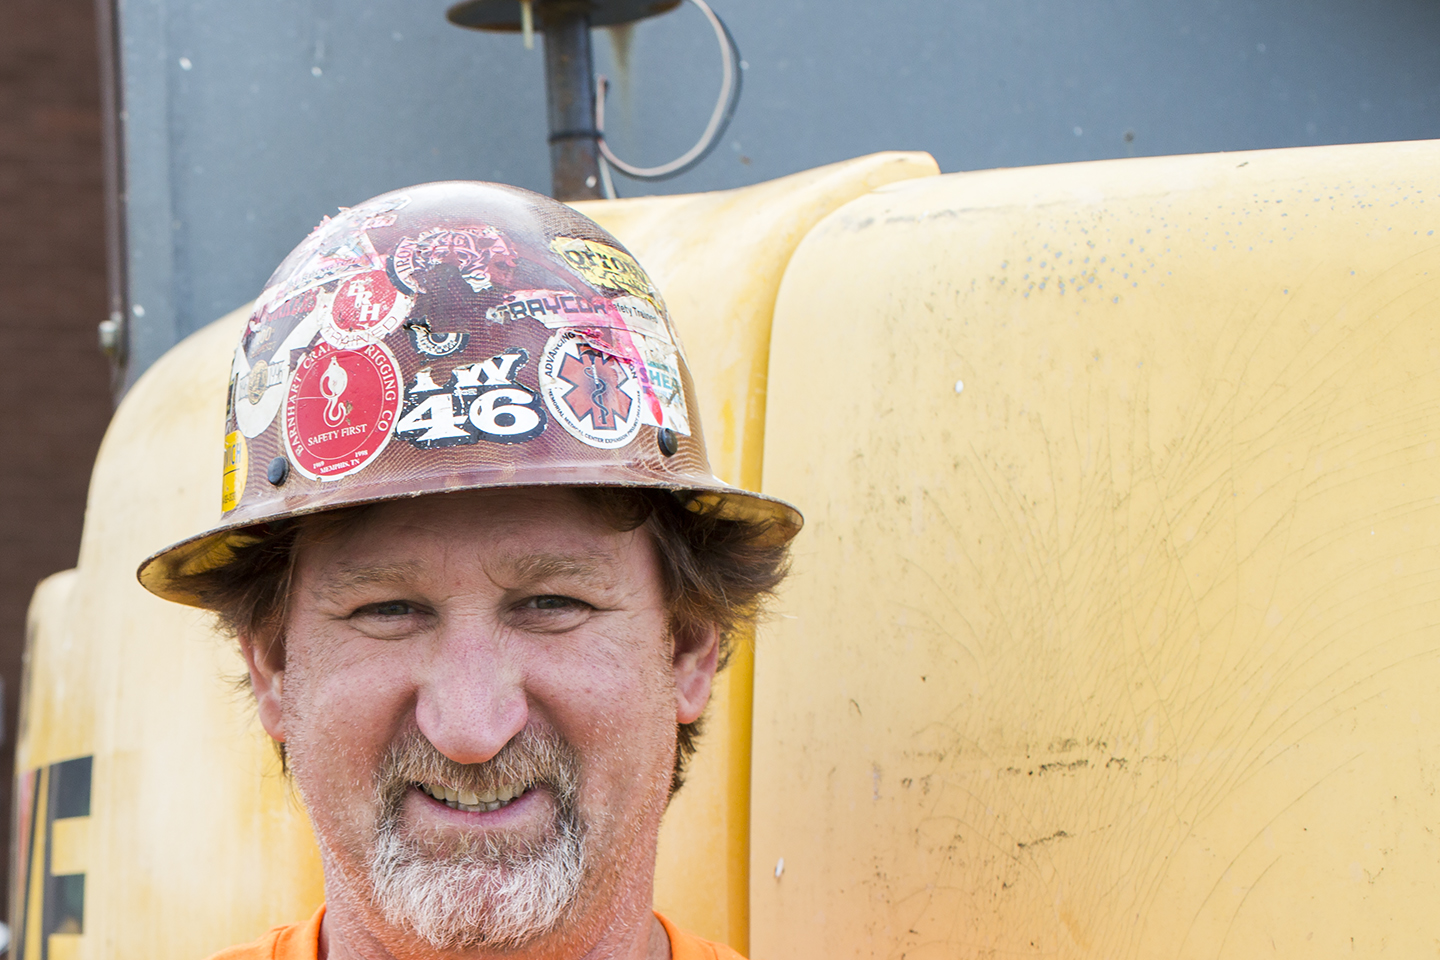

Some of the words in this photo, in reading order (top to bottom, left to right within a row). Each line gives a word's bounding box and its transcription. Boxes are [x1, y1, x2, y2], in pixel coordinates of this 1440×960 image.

[363, 344, 397, 401] RIGGING
[544, 331, 577, 378] ADVANCING
[287, 373, 304, 458] BARNHART
[307, 429, 340, 447] SAFETY
[341, 424, 368, 438] FIRST
[377, 410, 393, 432] CO
[396, 387, 541, 442] 46
